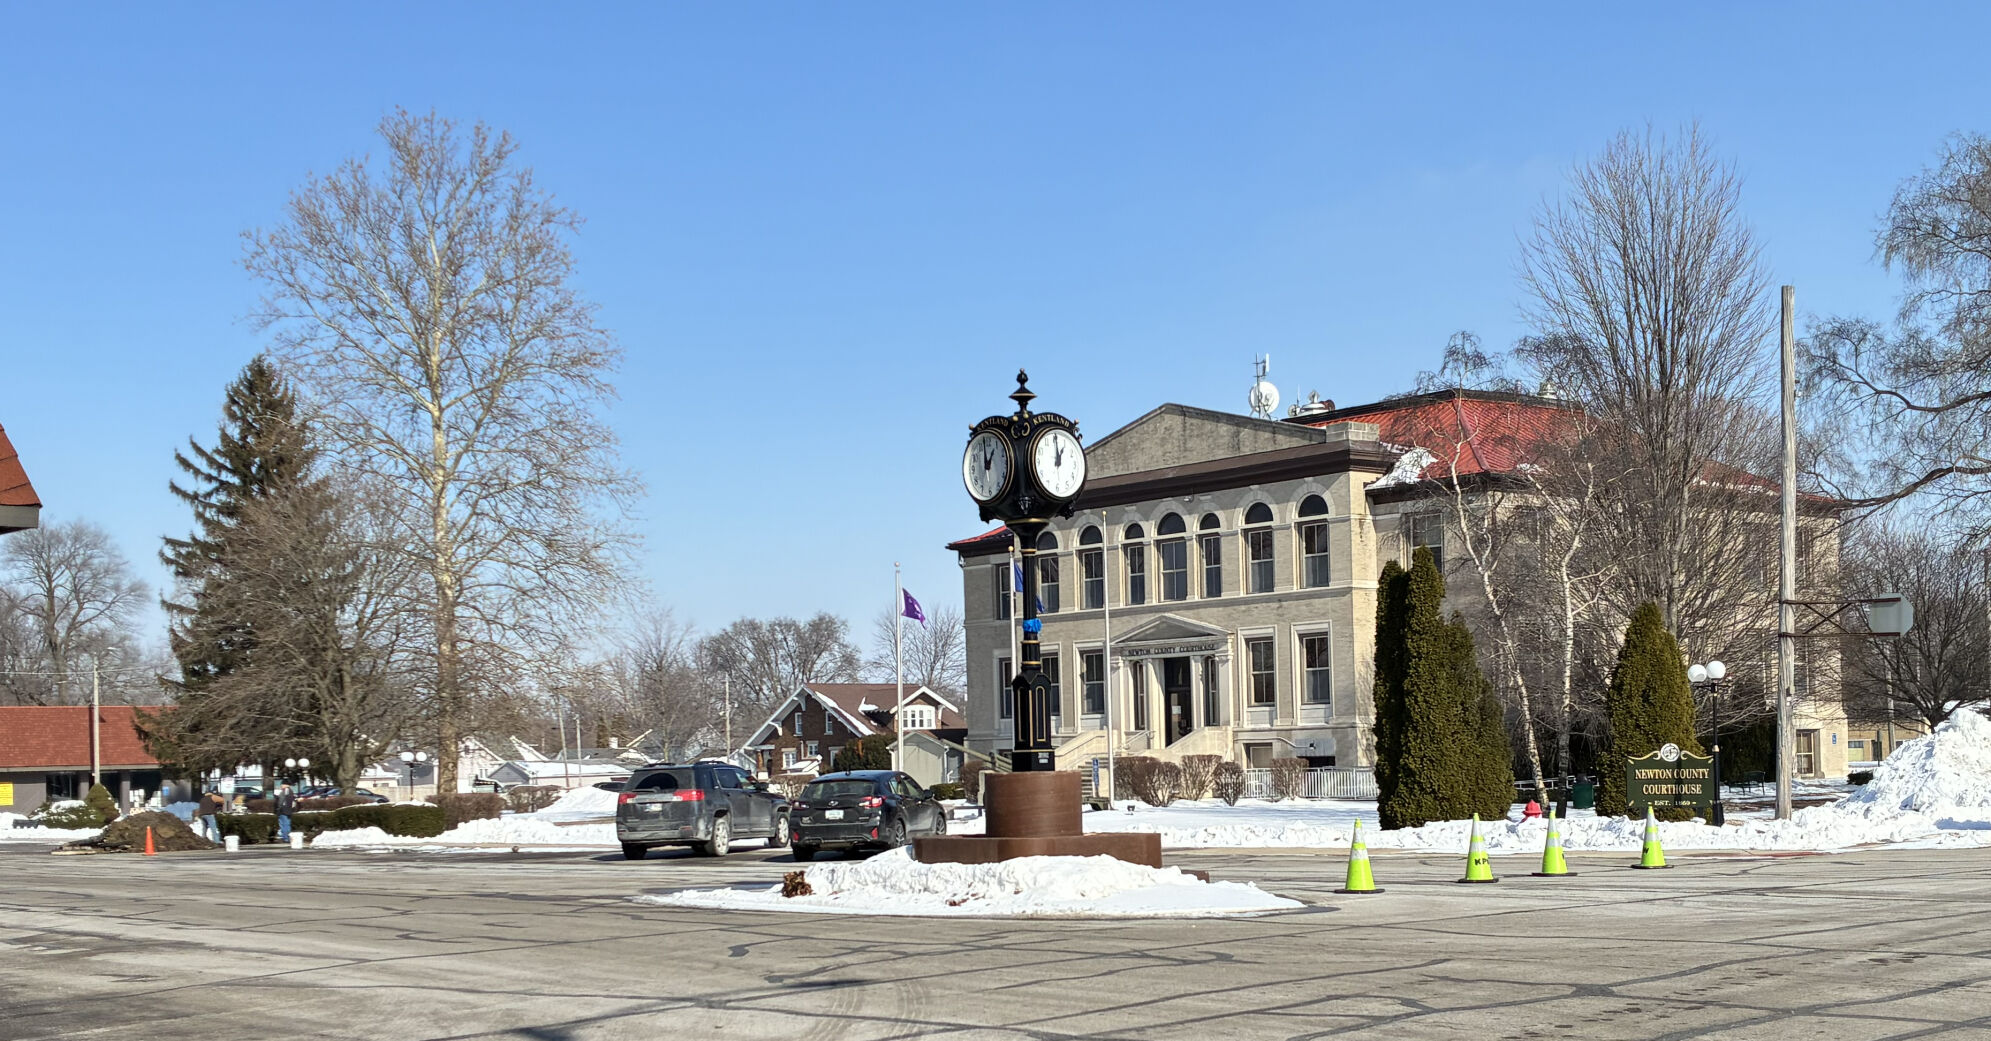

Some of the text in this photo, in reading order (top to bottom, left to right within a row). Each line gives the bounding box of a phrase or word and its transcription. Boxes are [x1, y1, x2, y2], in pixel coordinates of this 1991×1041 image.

[1033, 414, 1070, 428] KENTLAND
[1635, 768, 1709, 779] NEWTON COUNTY
[1643, 784, 1702, 795] COURTHOUSE
